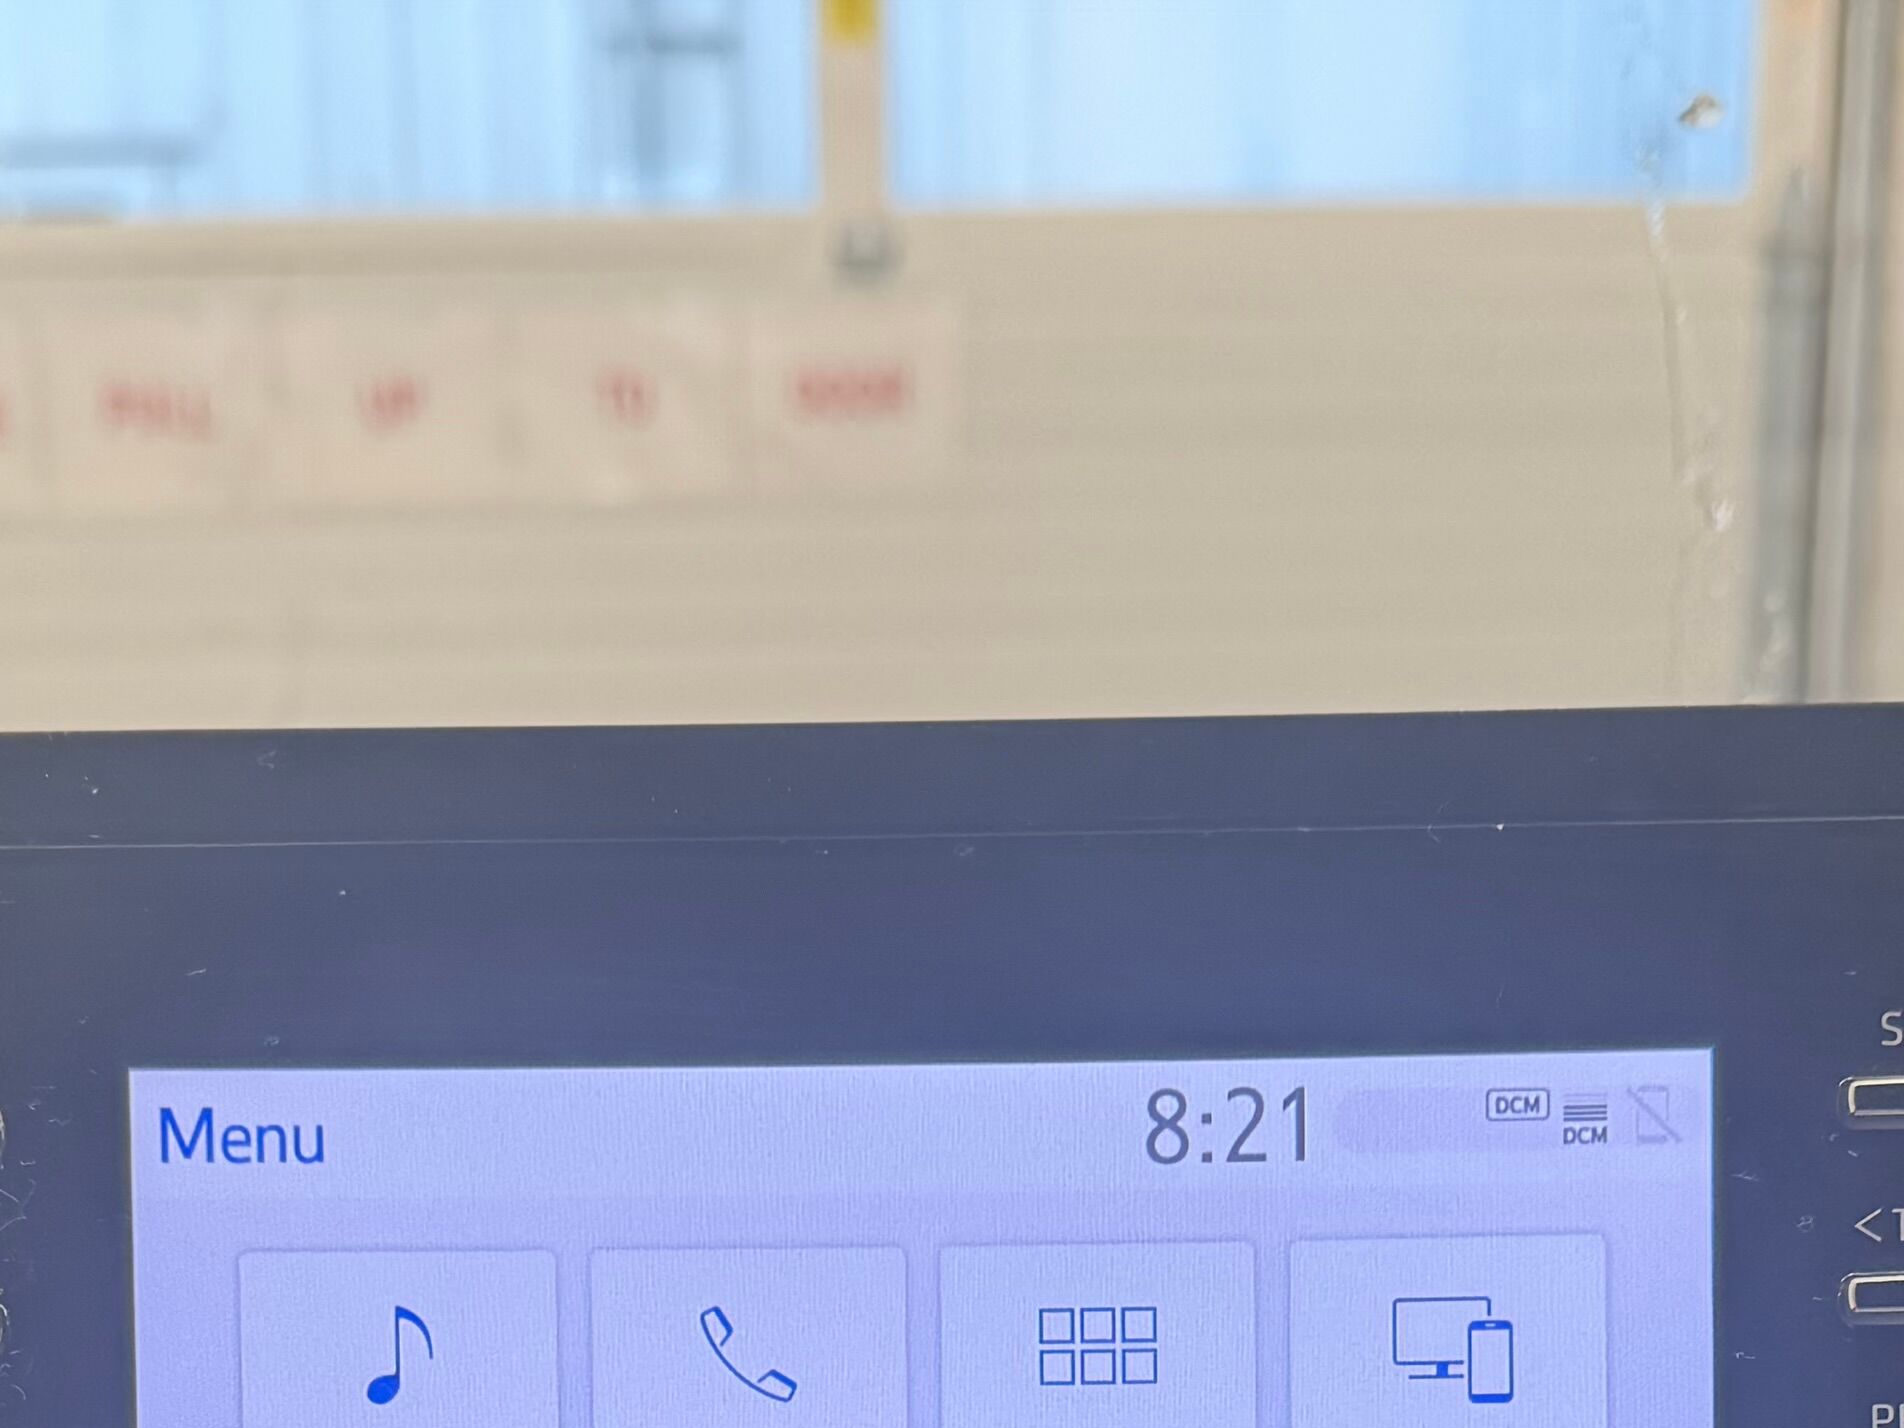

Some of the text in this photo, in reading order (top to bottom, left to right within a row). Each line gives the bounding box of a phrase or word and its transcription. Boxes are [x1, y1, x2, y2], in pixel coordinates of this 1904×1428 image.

[1145, 1085, 1311, 1165] 8:21
[1494, 1094, 1542, 1116] DCM
[159, 1106, 326, 1164] Menu
[1562, 1126, 1609, 1146] DCM
